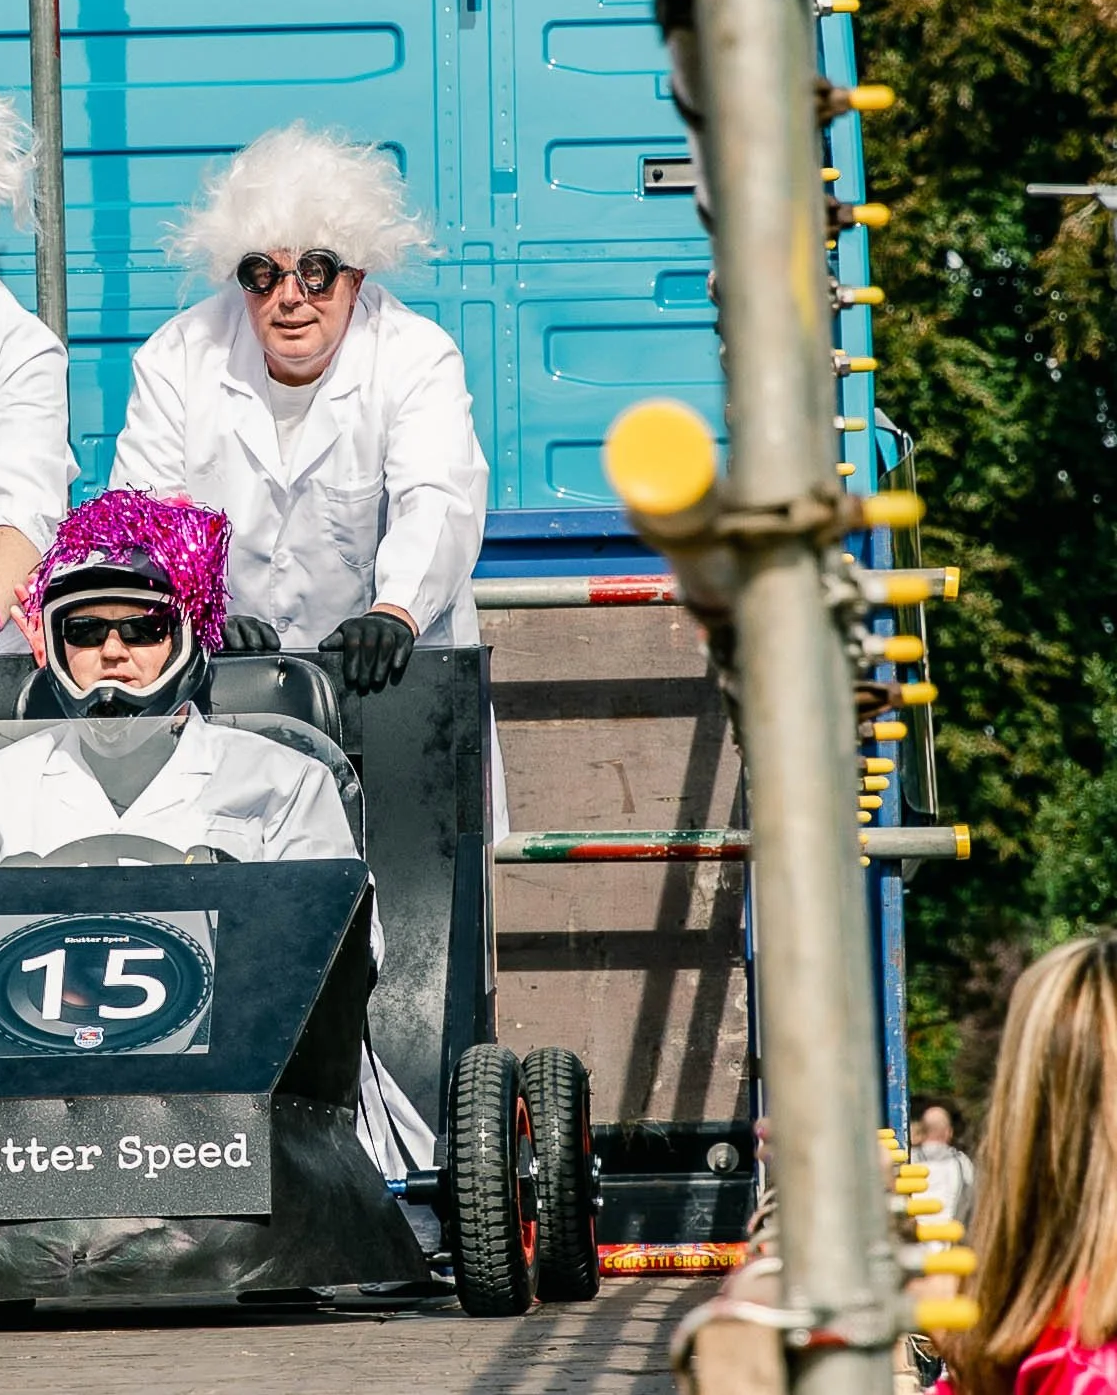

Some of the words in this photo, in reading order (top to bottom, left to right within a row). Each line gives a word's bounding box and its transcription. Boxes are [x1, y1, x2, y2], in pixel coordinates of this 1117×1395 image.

[21, 947, 167, 1021] 15
[117, 1132, 252, 1180] Speed
[604, 1254, 670, 1269] CONFETTI
